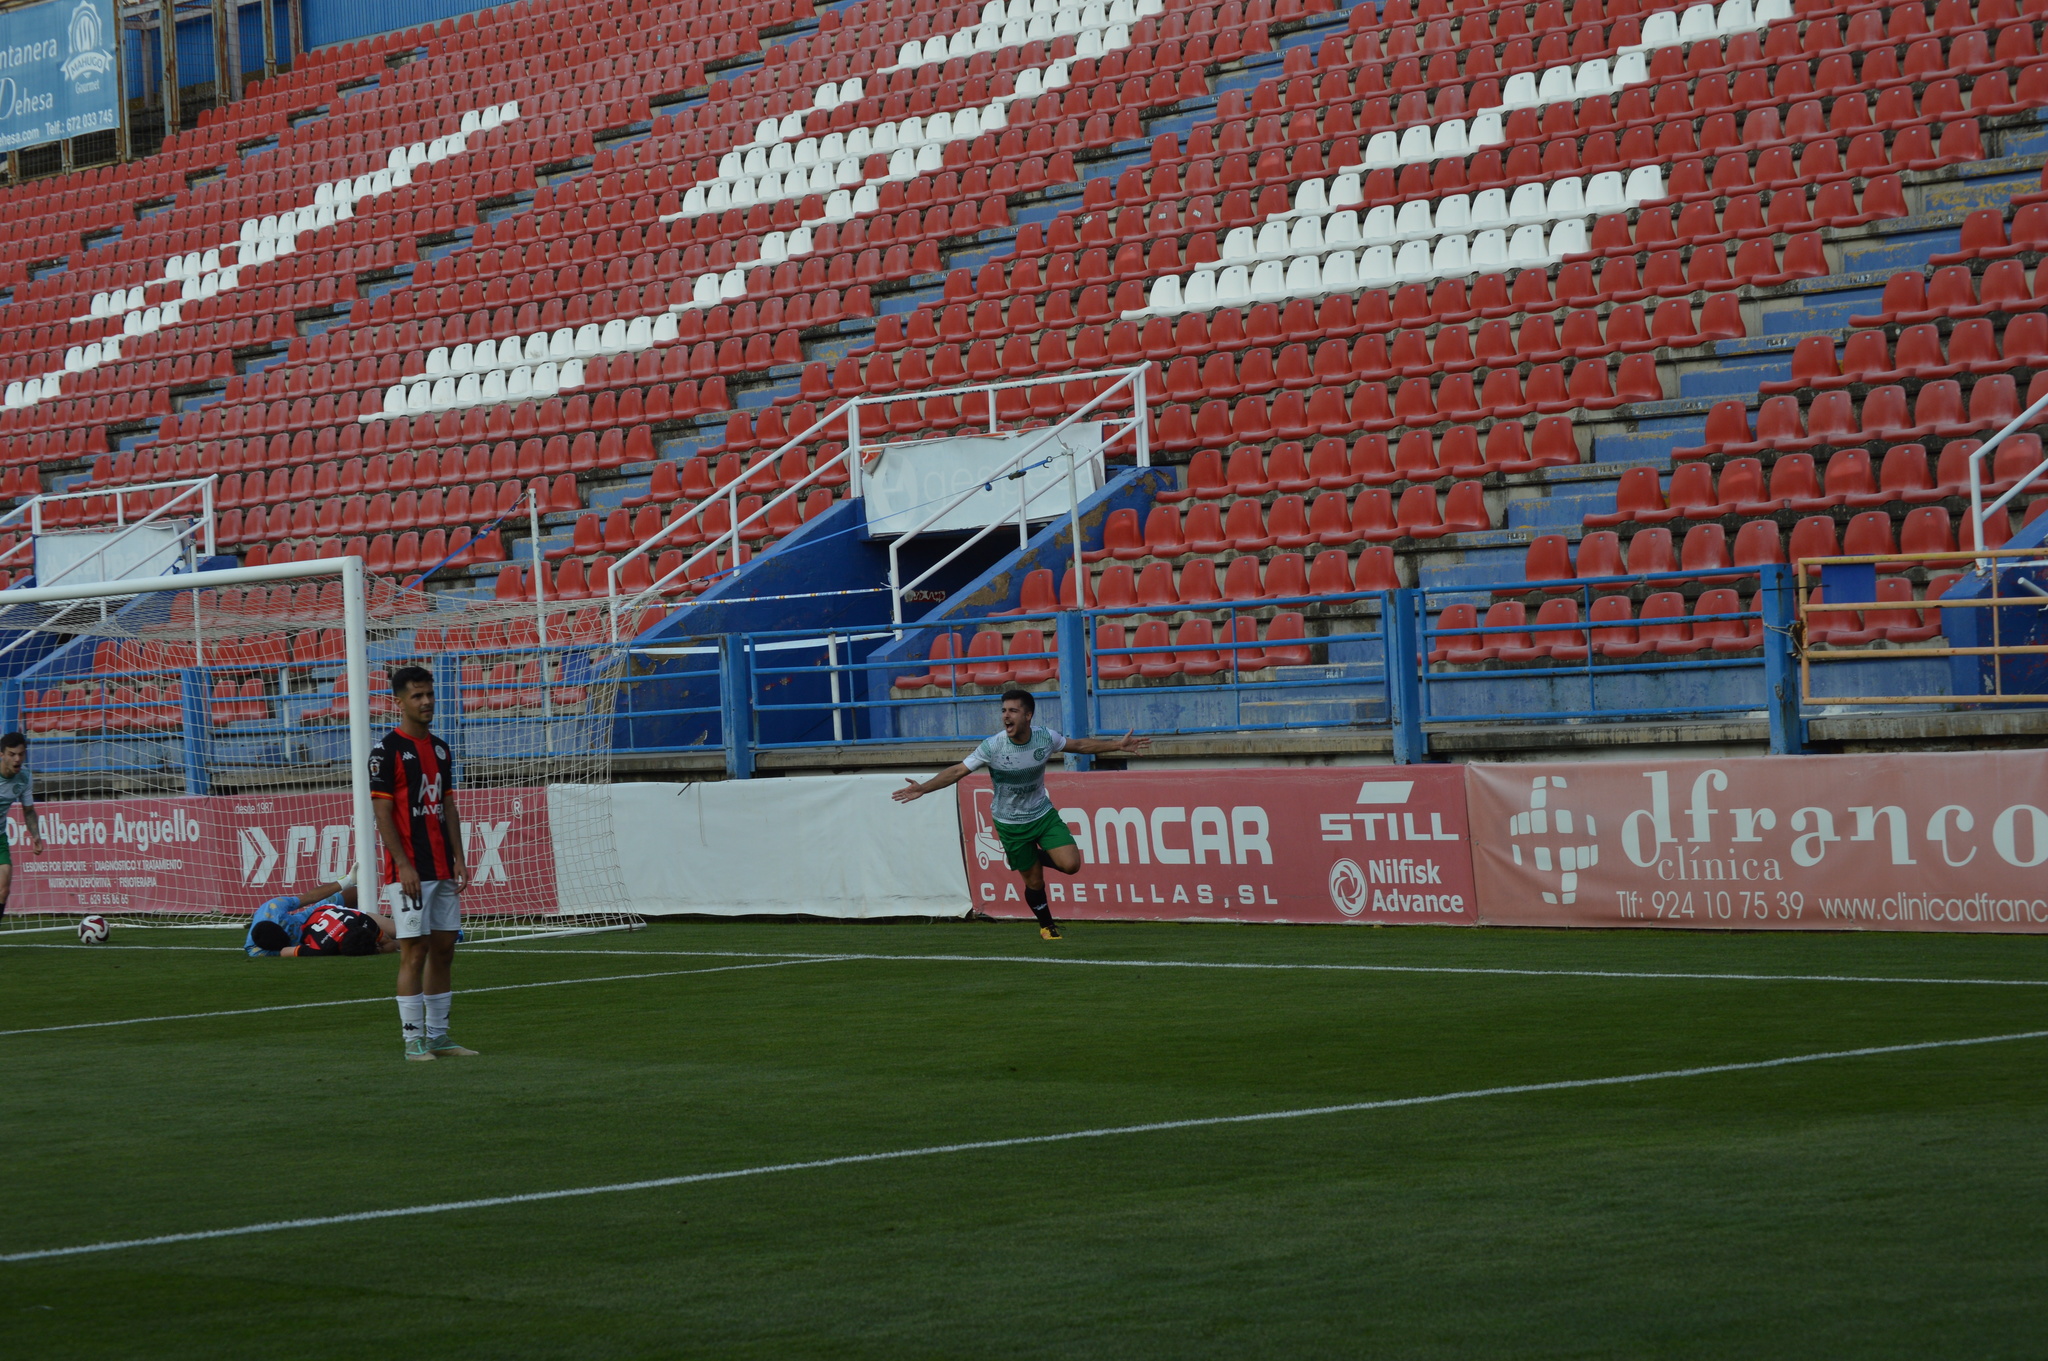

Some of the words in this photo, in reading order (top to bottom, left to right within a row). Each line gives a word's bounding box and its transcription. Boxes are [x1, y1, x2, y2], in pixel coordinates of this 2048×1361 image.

[75, 79, 100, 95] Gourmet
[66, 115, 81, 132] 672
[82, 111, 97, 127] 033
[99, 108, 113, 124] 745
[234, 802, 255, 814] desde
[256, 802, 273, 814] 1987
[1621, 769, 2048, 868] dfranco
[6, 816, 31, 846] Dr.
[38, 812, 107, 845] Alberto
[112, 808, 200, 852] Argüello
[1046, 788, 1273, 865] AMCAR
[1320, 813, 1460, 841] STILL
[22, 861, 49, 872] LESIONES
[49, 861, 62, 872] POR
[62, 861, 87, 872] DEPORTE
[142, 859, 182, 870] TRATAMIENTO
[1368, 858, 1442, 884] Nilfisk
[1657, 845, 1784, 881] clínica
[80, 877, 111, 888] DEPORTIVA
[119, 876, 157, 888] FISIOTERAPIA
[90, 894, 101, 904] 629
[102, 894, 111, 904] 55
[121, 894, 129, 904] 65
[1372, 888, 1464, 913] Advance
[1651, 891, 1695, 919] 924
[1704, 891, 1732, 919] 10
[1739, 891, 1769, 919] 75
[1776, 891, 1804, 919] 39
